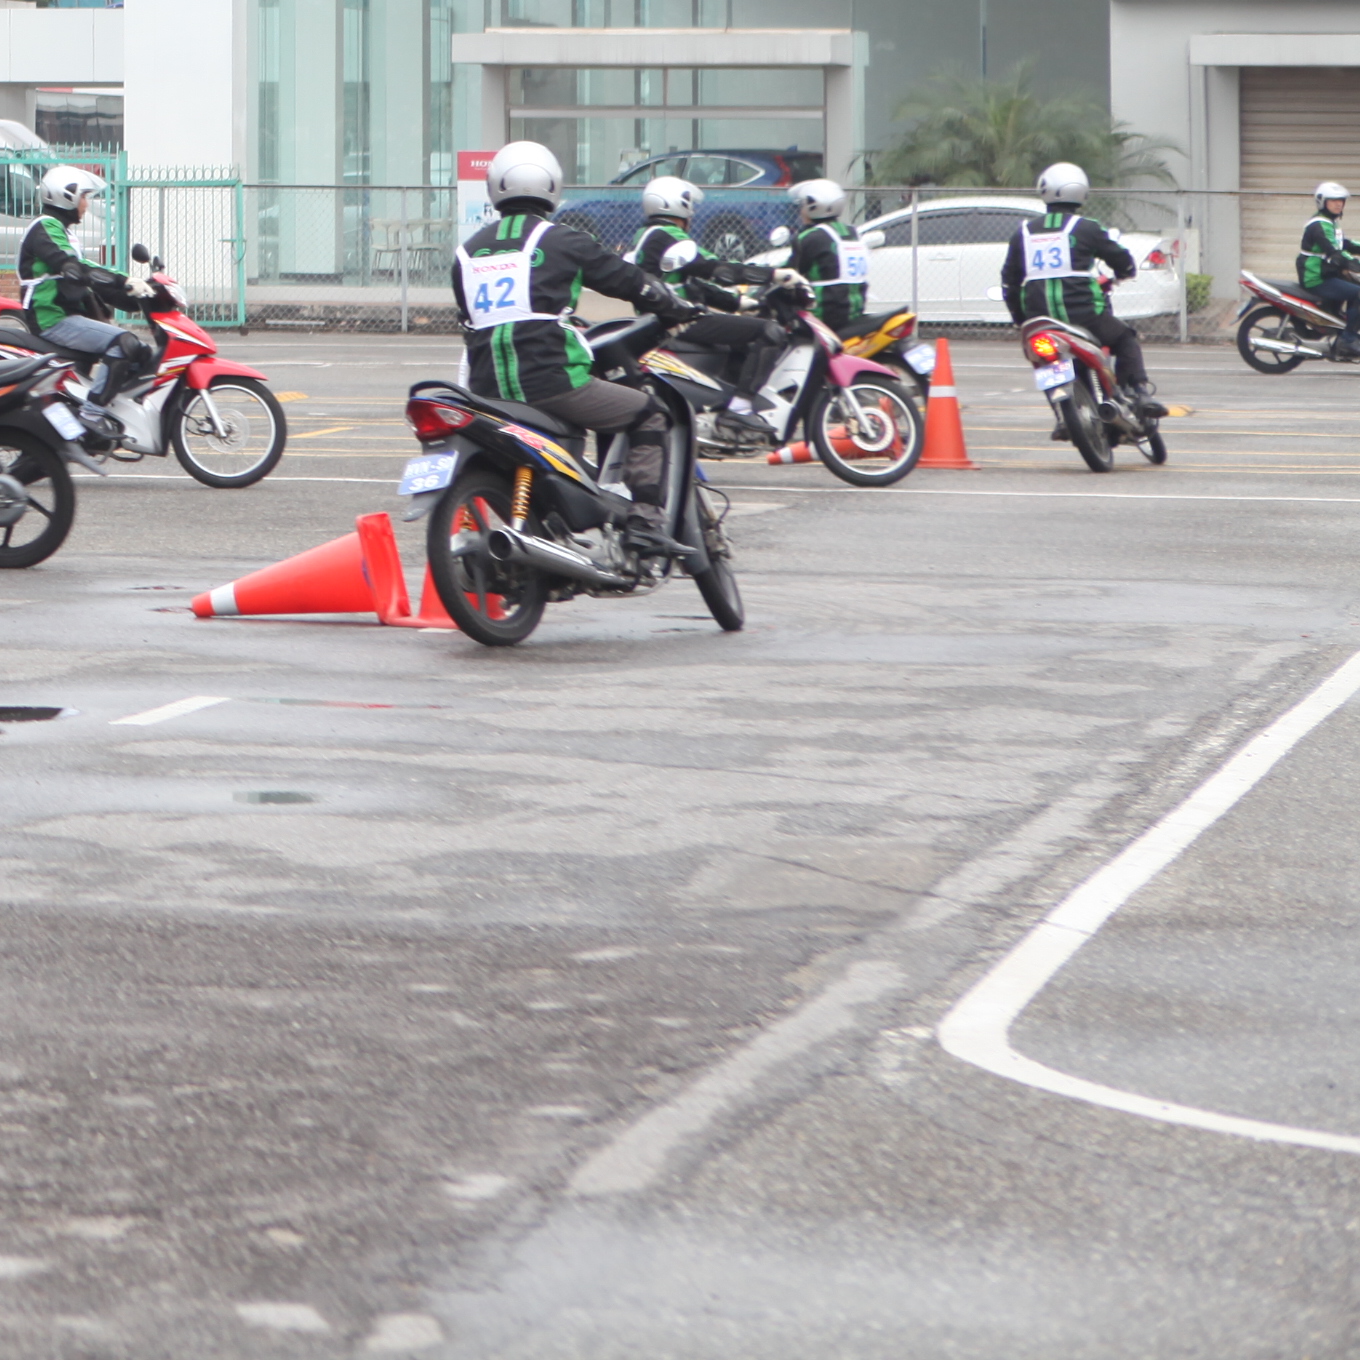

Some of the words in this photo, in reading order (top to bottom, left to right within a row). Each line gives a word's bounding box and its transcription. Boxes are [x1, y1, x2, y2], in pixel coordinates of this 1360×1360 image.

[472, 262, 519, 274] HONDA
[1032, 247, 1063, 270] 43
[473, 276, 516, 314] 42
[408, 474, 440, 491] 36
